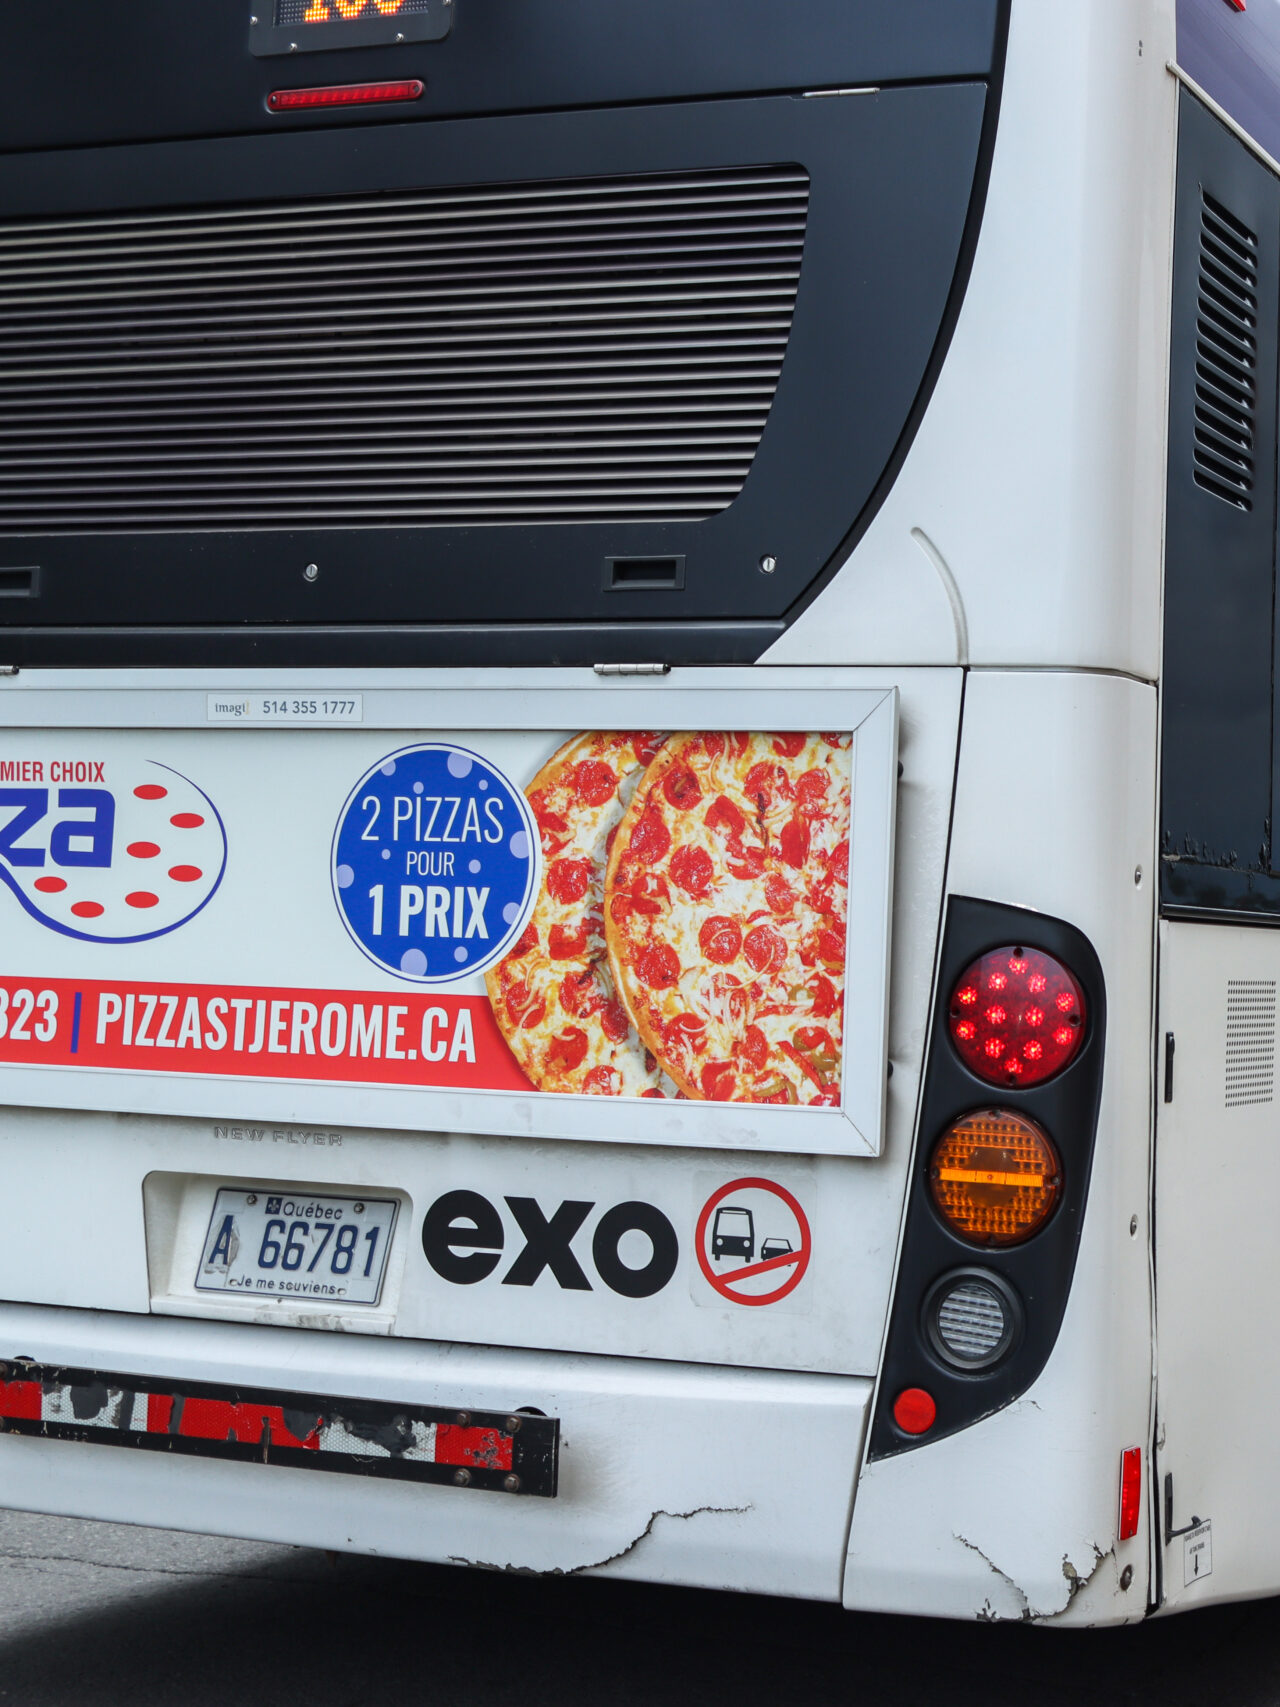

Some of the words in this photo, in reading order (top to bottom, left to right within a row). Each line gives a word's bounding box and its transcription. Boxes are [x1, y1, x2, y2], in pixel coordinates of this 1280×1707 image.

[263, 701, 288, 714] 514
[292, 701, 317, 714] 355
[322, 701, 355, 714] 1777
[0, 761, 44, 782] MIER
[50, 761, 105, 783] CHOIX
[361, 795, 381, 841] 2
[393, 796, 504, 844] PIZZAS
[406, 850, 455, 877] POUR
[368, 884, 384, 936] 1
[398, 884, 491, 939] PRIX
[96, 992, 477, 1064] PIZZASTJEROME.CA
[214, 1126, 265, 1142] NEW
[272, 1130, 344, 1147] FLYER
[283, 1201, 344, 1220] Québec
[208, 1215, 234, 1265] A
[257, 1219, 380, 1278] 66781
[421, 1189, 679, 1299] exo
[236, 1274, 252, 1288] Je
[256, 1278, 276, 1290] me
[279, 1280, 337, 1295] souviens
